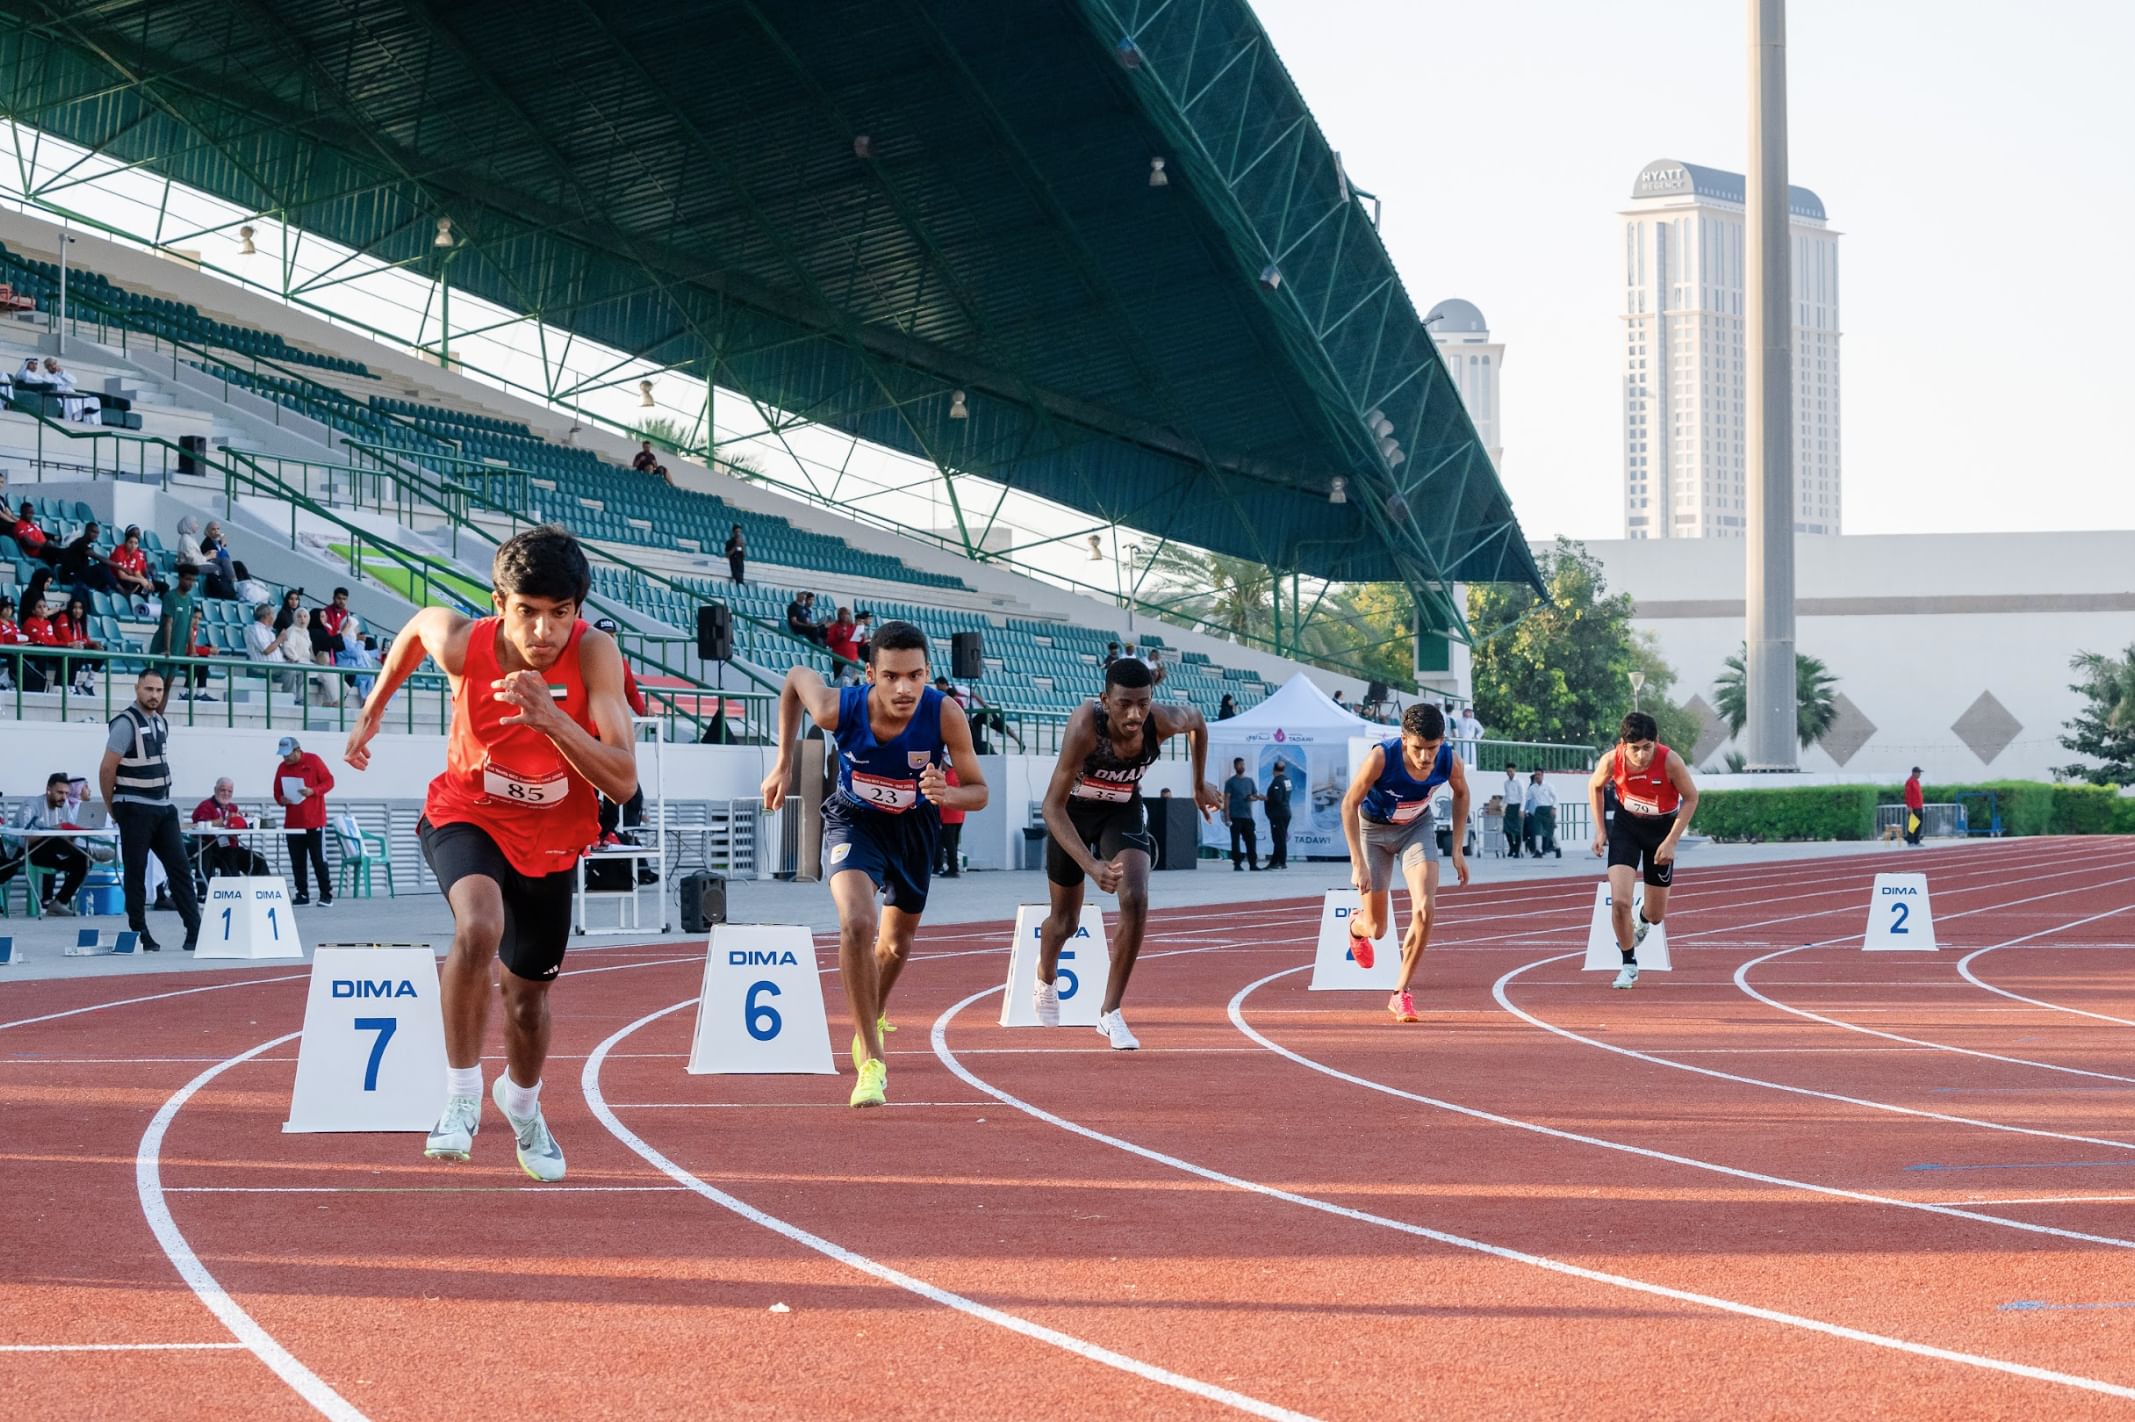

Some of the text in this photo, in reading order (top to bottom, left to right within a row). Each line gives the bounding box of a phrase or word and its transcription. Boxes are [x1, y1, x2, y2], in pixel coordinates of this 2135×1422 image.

[1642, 169, 1683, 182] HYATT
[1095, 765, 1147, 782] OMAN
[507, 783, 545, 801] 85
[870, 788, 898, 804] 23
[1633, 803, 1649, 813] 79
[1294, 836, 1331, 844] TADAWI
[213, 890, 242, 899] DIMA
[256, 890, 282, 899] DIMA
[1882, 887, 1918, 895] DIMA
[222, 907, 231, 940] 1
[267, 907, 279, 940] 1
[1890, 902, 1909, 934] 2
[729, 951, 798, 965] DIMA
[1056, 951, 1079, 1000] 5
[332, 980, 418, 998] DIMA
[745, 980, 782, 1041] 6
[354, 1017, 397, 1091] 7
